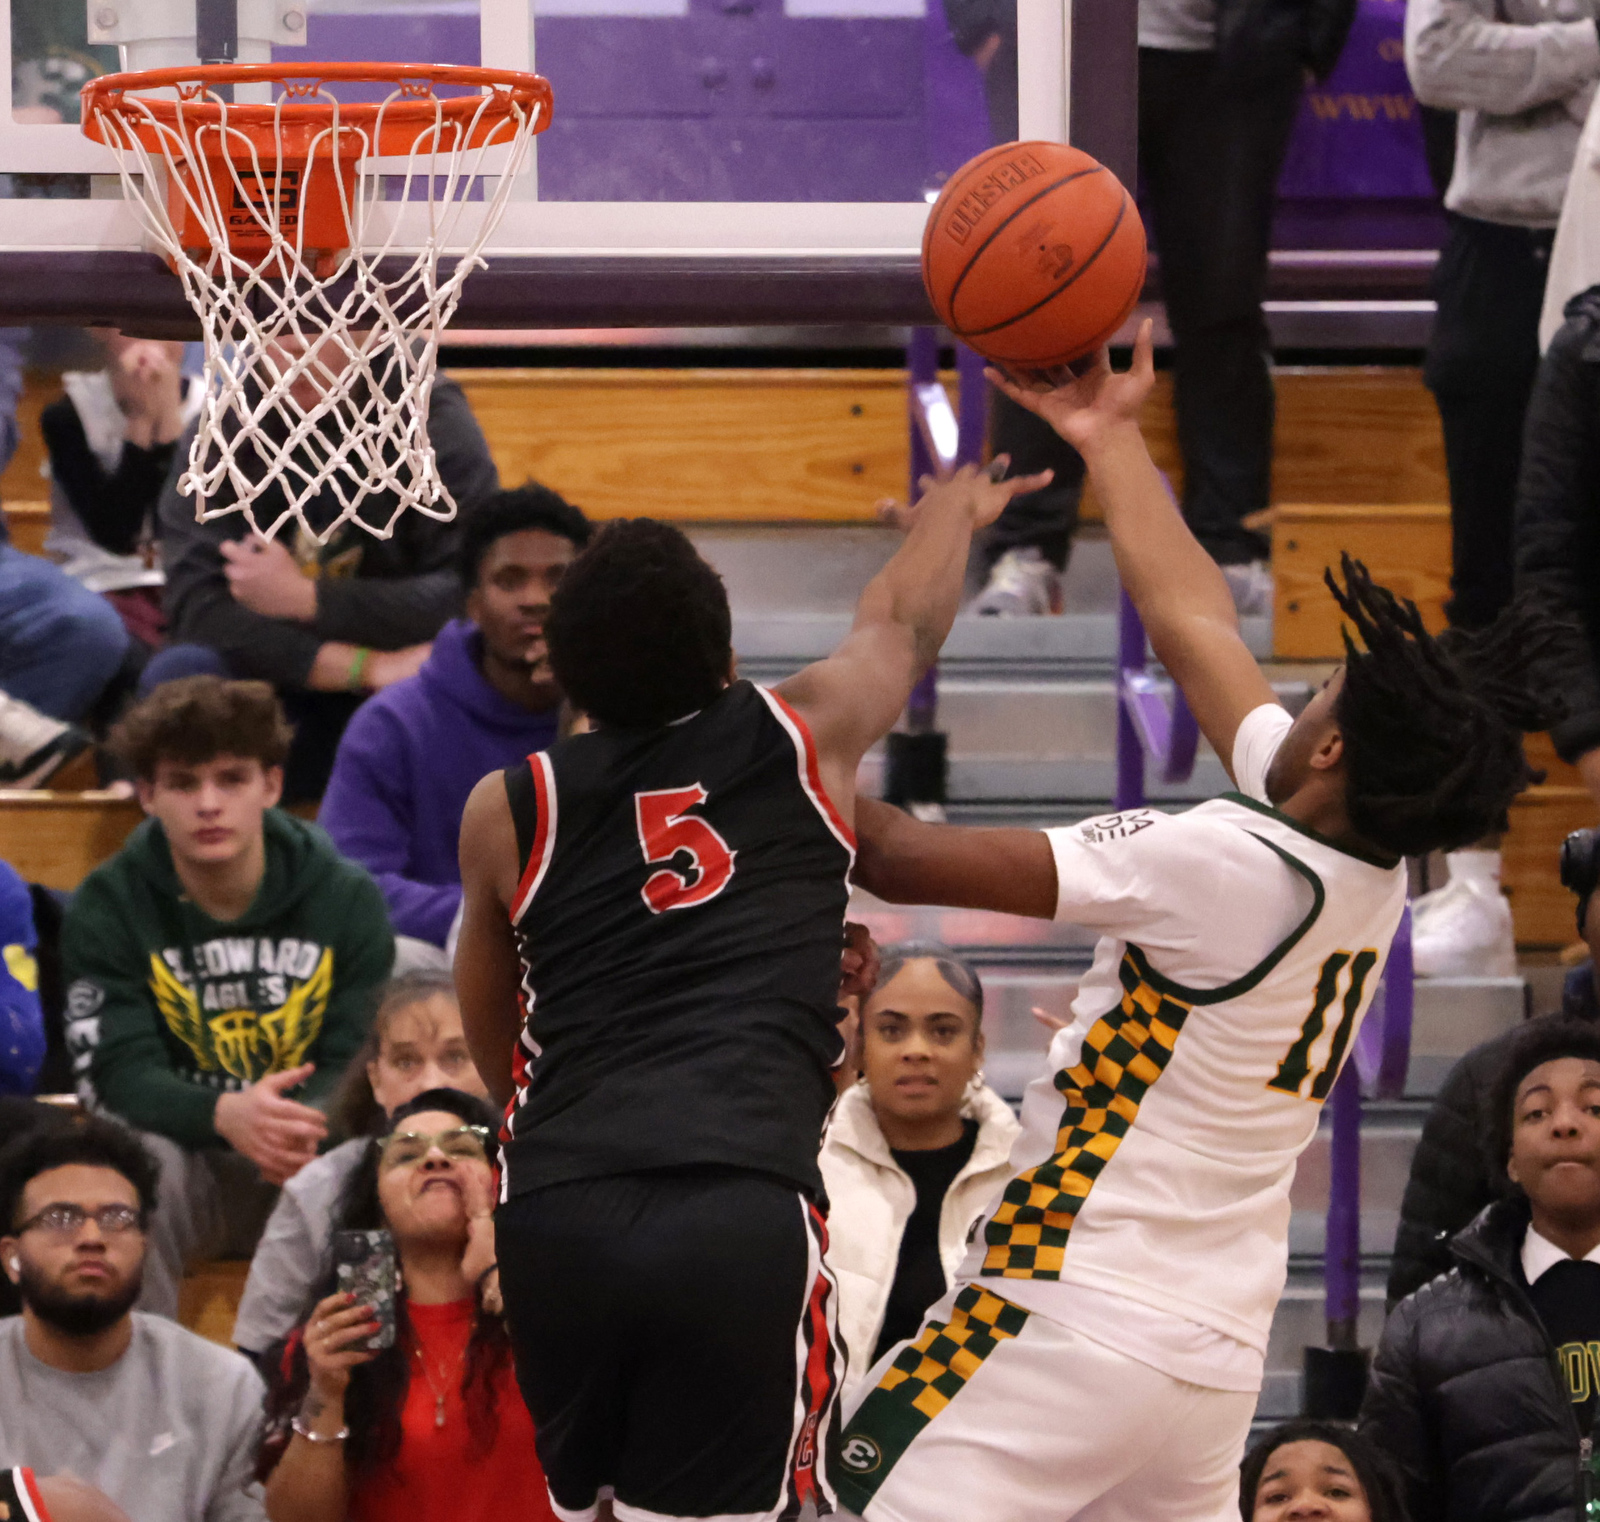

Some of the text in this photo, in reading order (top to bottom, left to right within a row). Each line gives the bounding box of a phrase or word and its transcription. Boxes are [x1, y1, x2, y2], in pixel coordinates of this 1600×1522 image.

[945, 152, 1047, 247] OHSAA
[634, 781, 739, 915] 5
[1265, 947, 1380, 1104] 11
